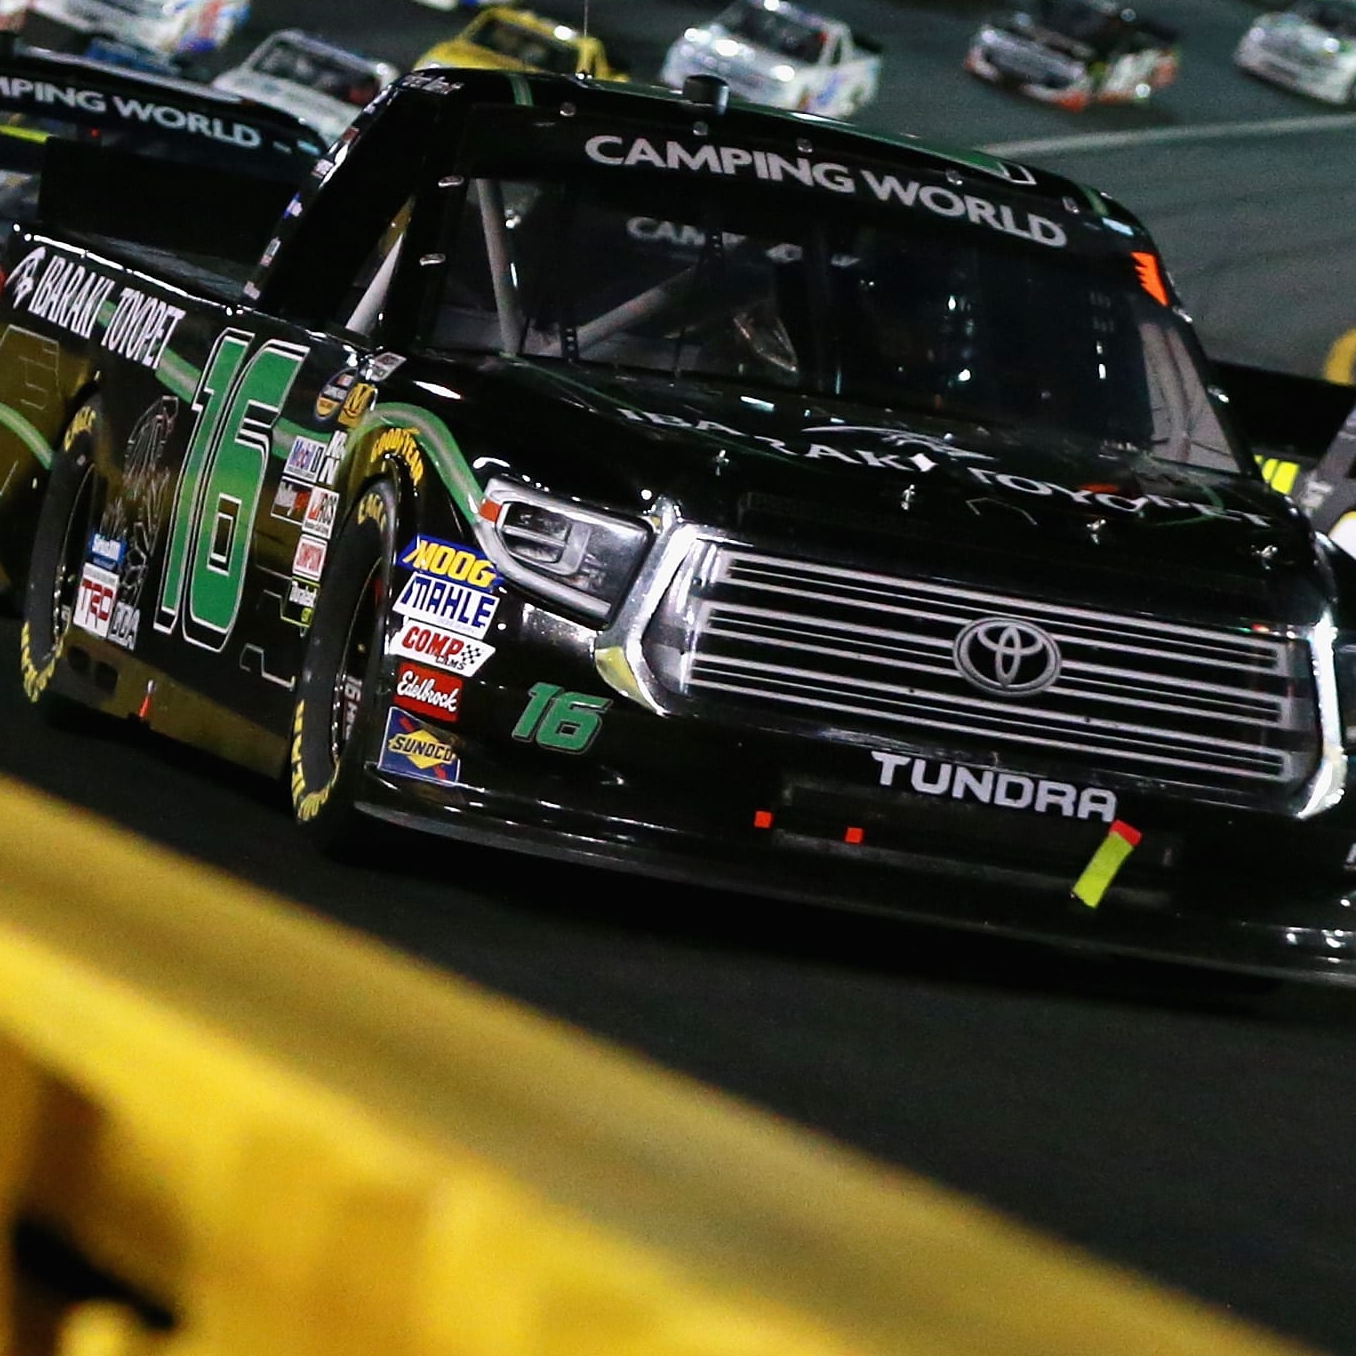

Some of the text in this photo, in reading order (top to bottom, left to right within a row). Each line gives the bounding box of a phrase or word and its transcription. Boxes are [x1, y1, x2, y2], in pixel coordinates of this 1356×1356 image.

[113, 95, 262, 148] WORLD
[585, 135, 1068, 248] CAMPING WORLD
[28, 255, 187, 370] IBARAKI TOYOPET
[153, 327, 310, 652] 16
[402, 539, 497, 588] MOOG
[400, 576, 496, 628] MAHLE
[402, 626, 465, 658] COMP
[397, 670, 459, 712] Edelbrock
[511, 681, 614, 755] 16
[392, 735, 455, 763] SUNOCO
[870, 750, 1118, 823] TUNDRA
